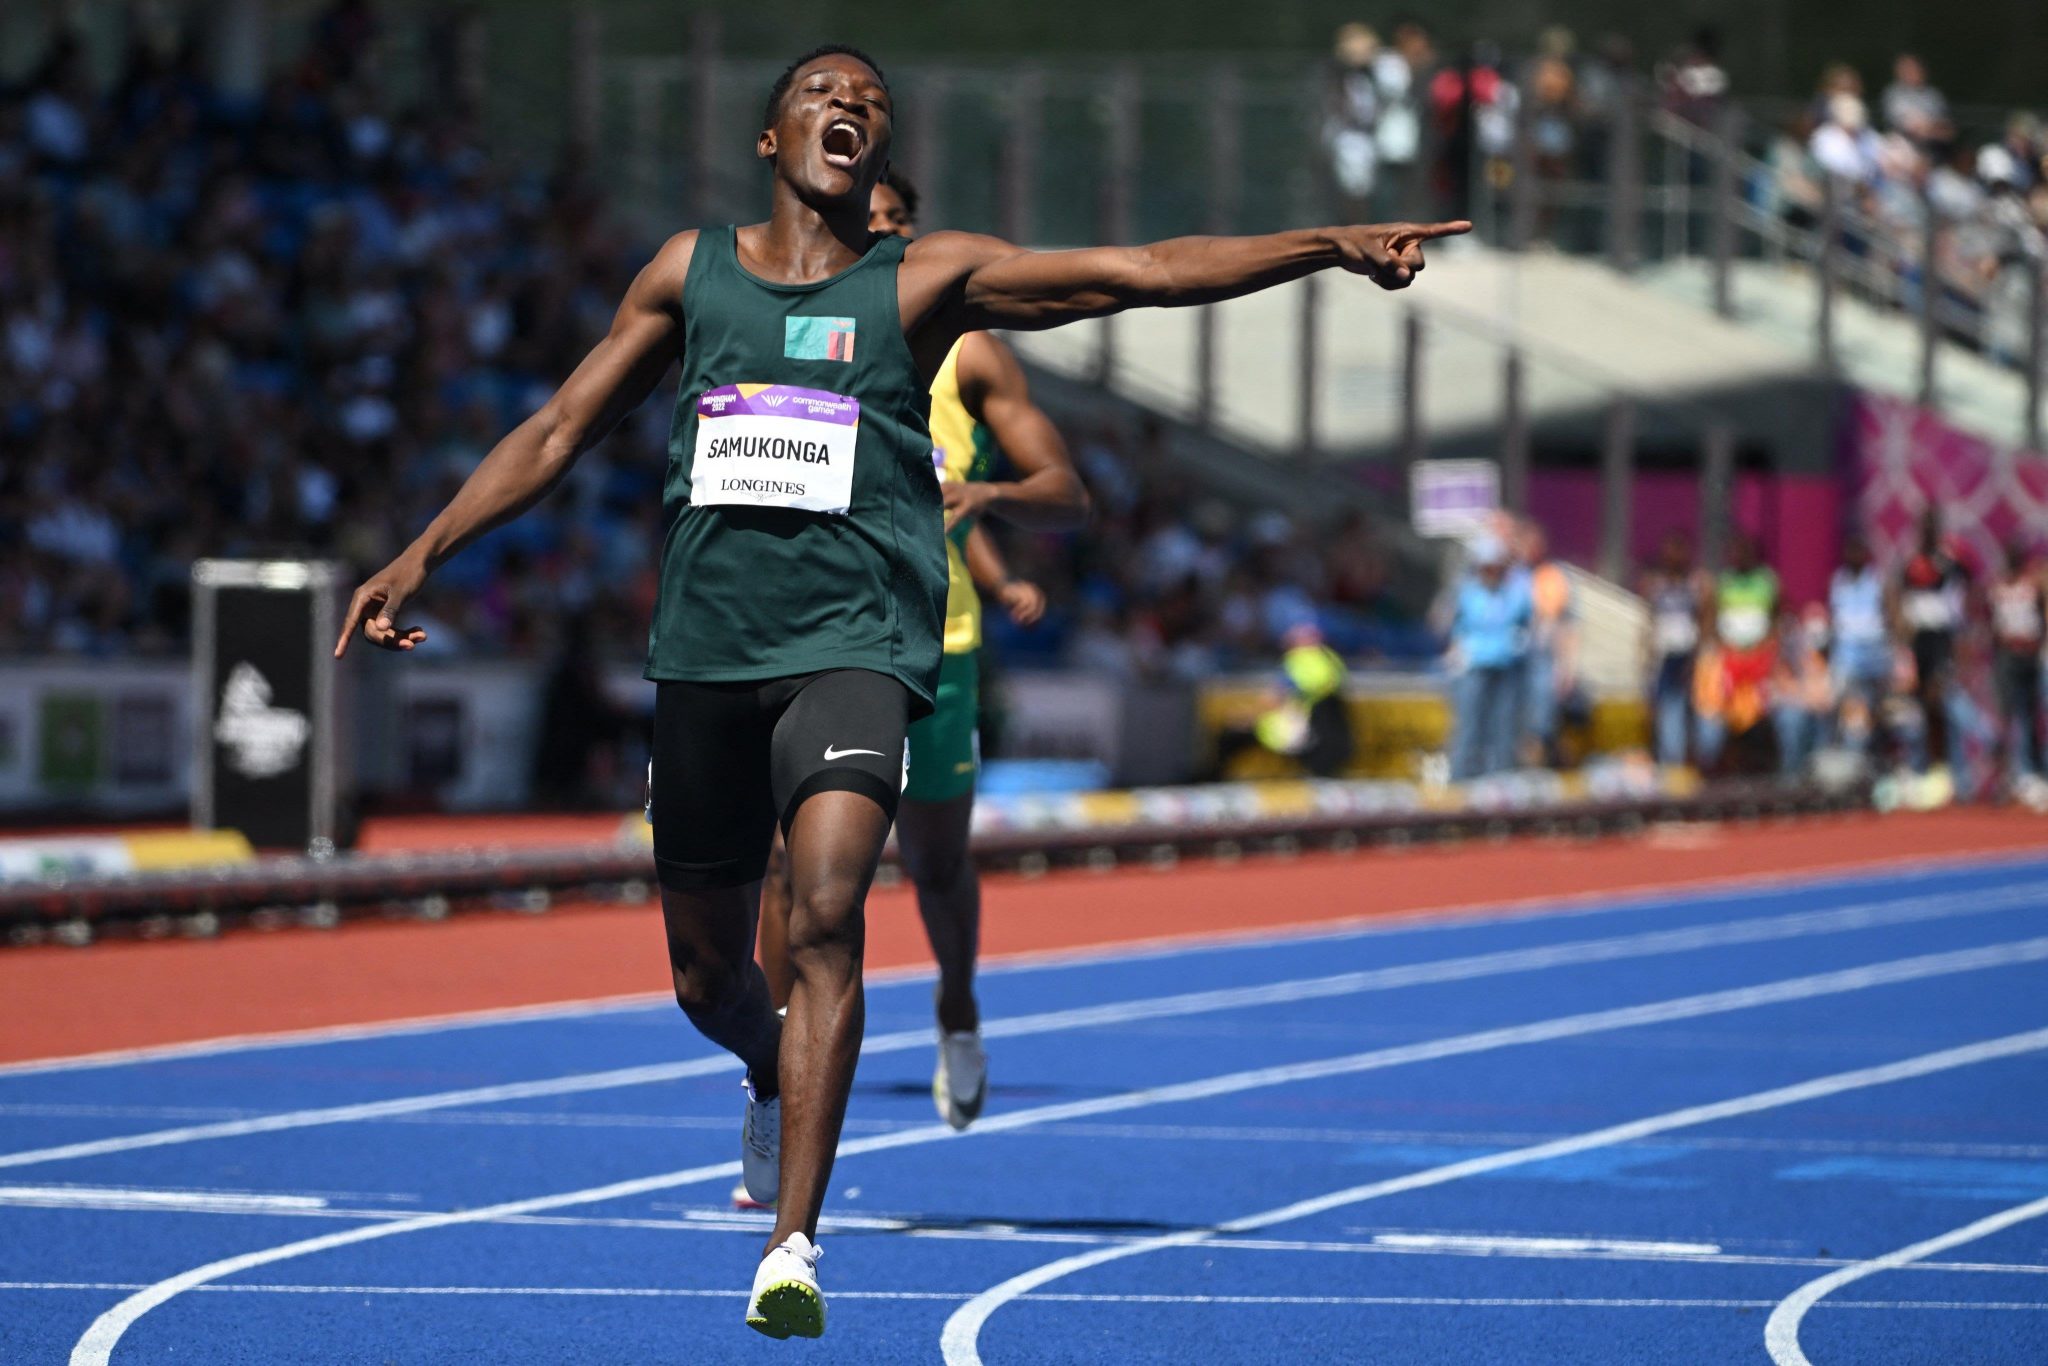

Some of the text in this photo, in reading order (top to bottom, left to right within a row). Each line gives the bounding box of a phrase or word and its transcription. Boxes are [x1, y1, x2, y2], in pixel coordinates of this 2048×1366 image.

[702, 394, 737, 405] BIRMINGHAM
[792, 396, 852, 411] commonwealth
[711, 403, 726, 412] 2022
[808, 405, 835, 415] games
[707, 436, 830, 465] SAMUKONGA
[721, 478, 806, 496] LONGINES
